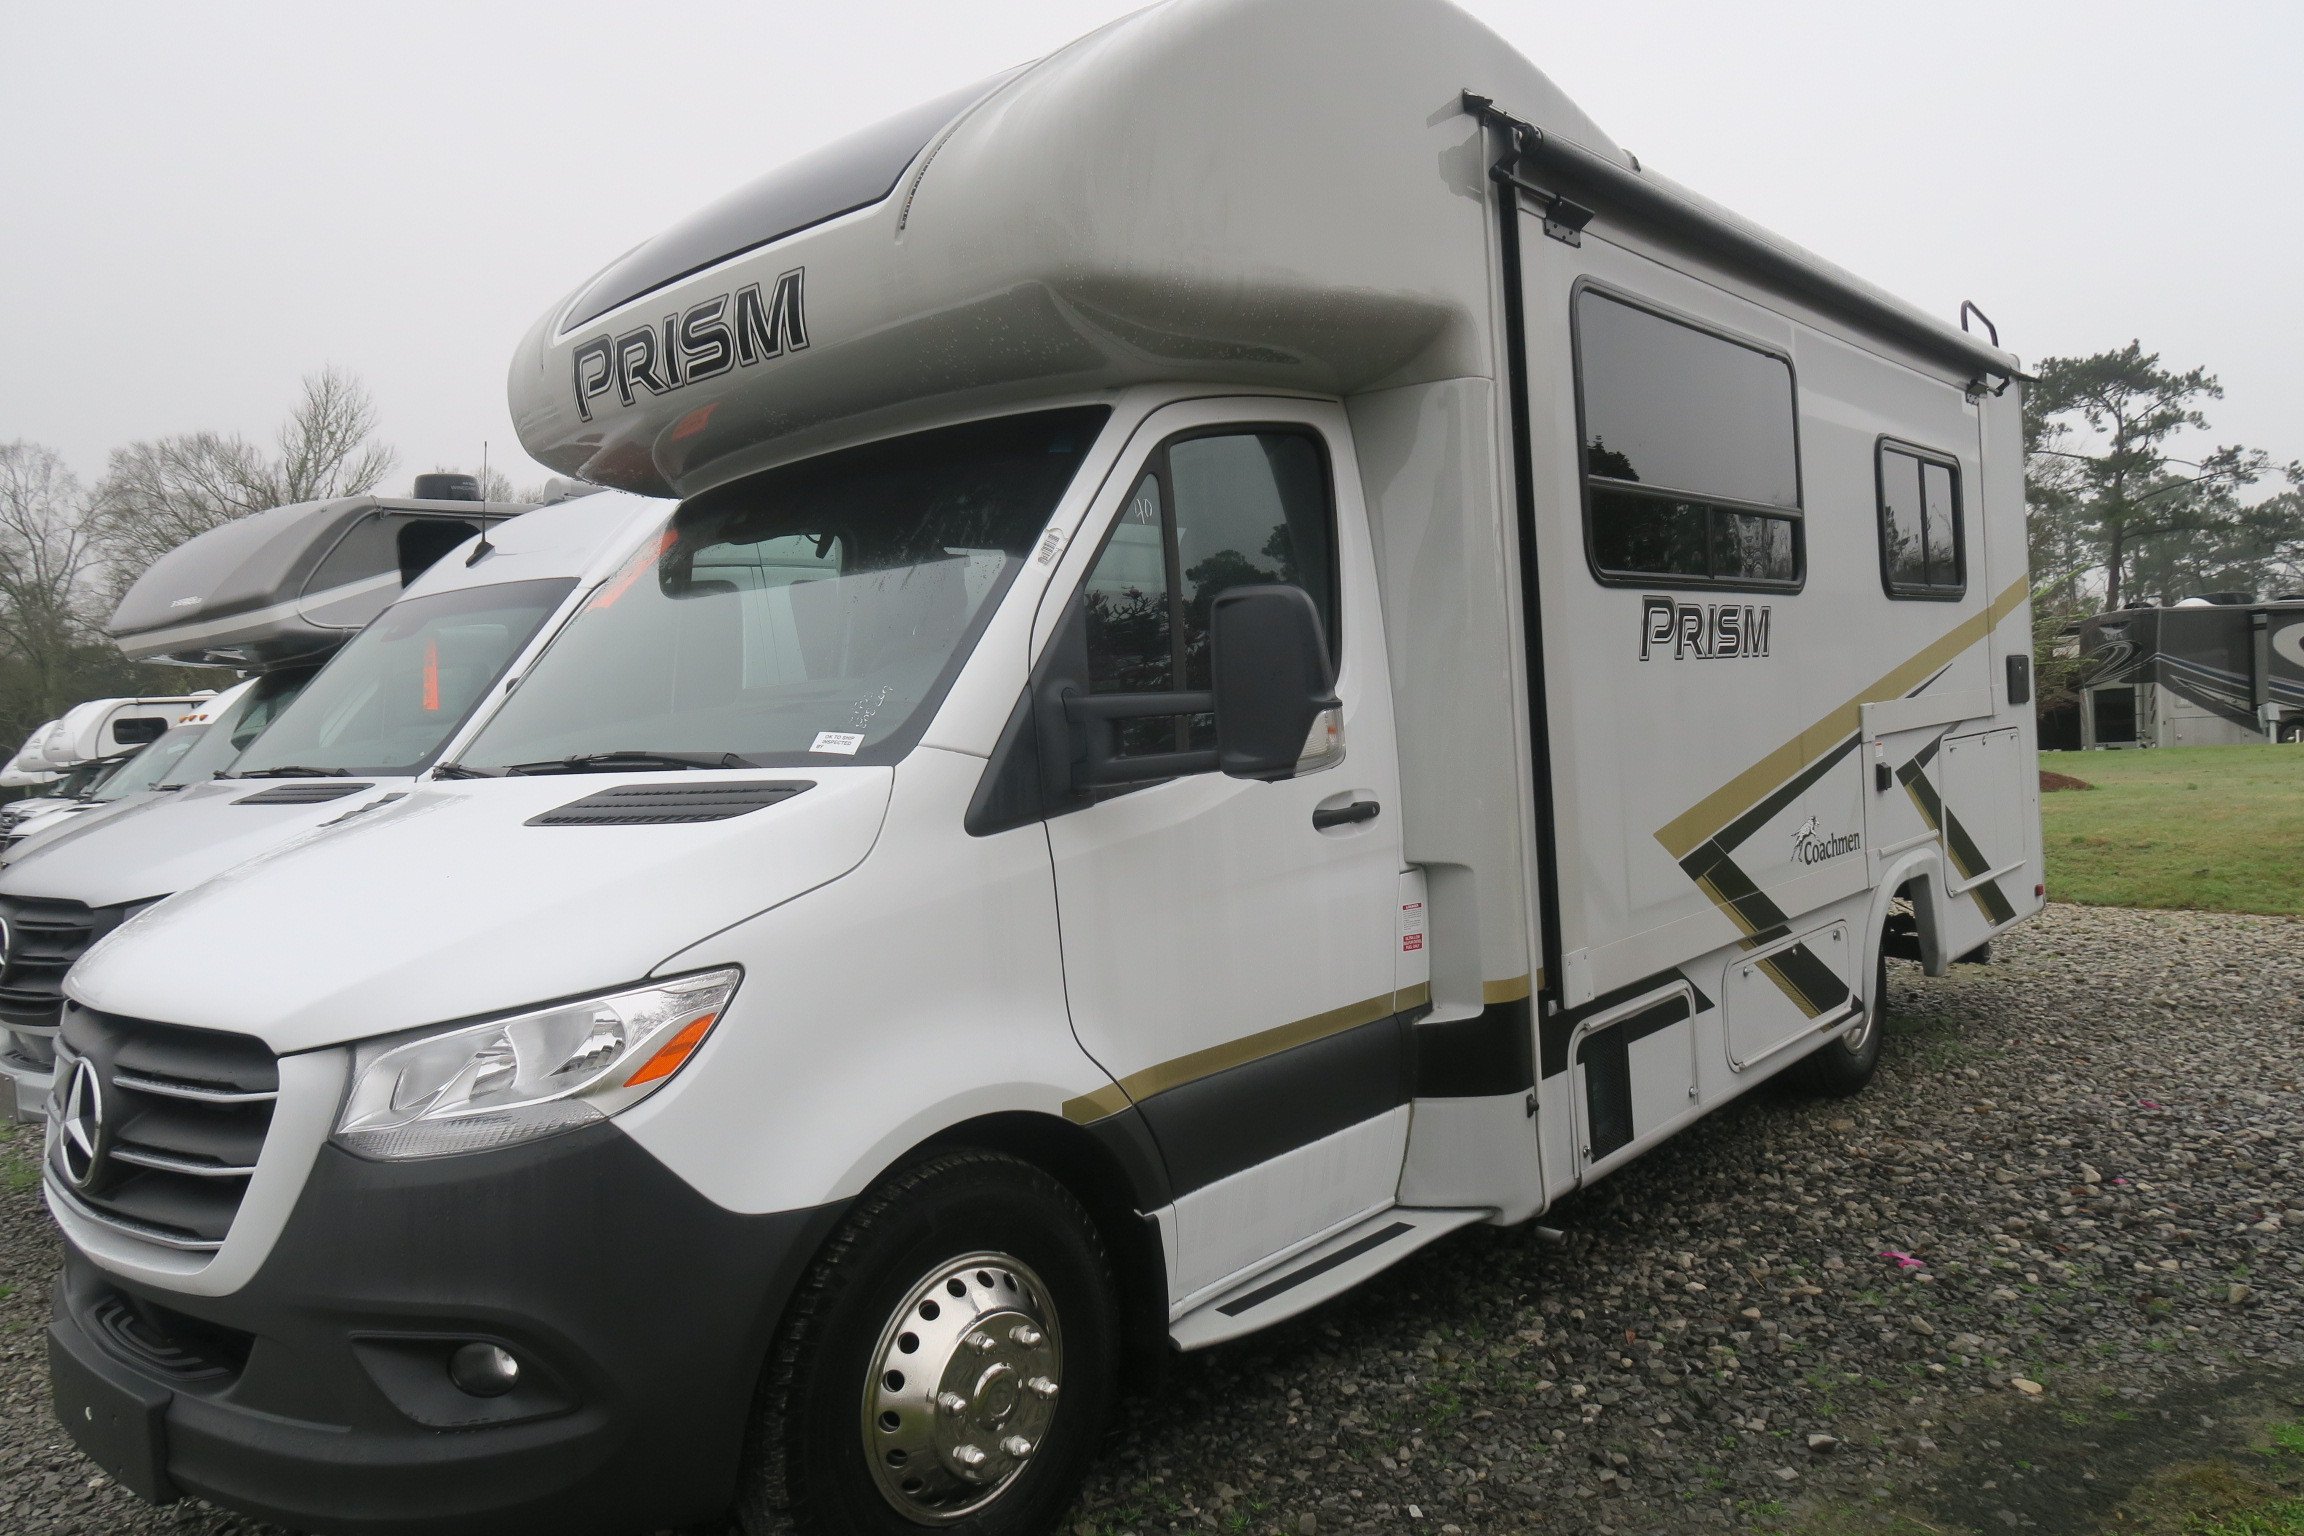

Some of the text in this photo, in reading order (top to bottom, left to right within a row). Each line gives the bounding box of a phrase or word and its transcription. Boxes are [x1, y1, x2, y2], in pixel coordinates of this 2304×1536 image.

[572, 265, 811, 423] PRISM
[1639, 594, 1772, 662] PRISM
[1804, 832, 1861, 866] Coachmen
